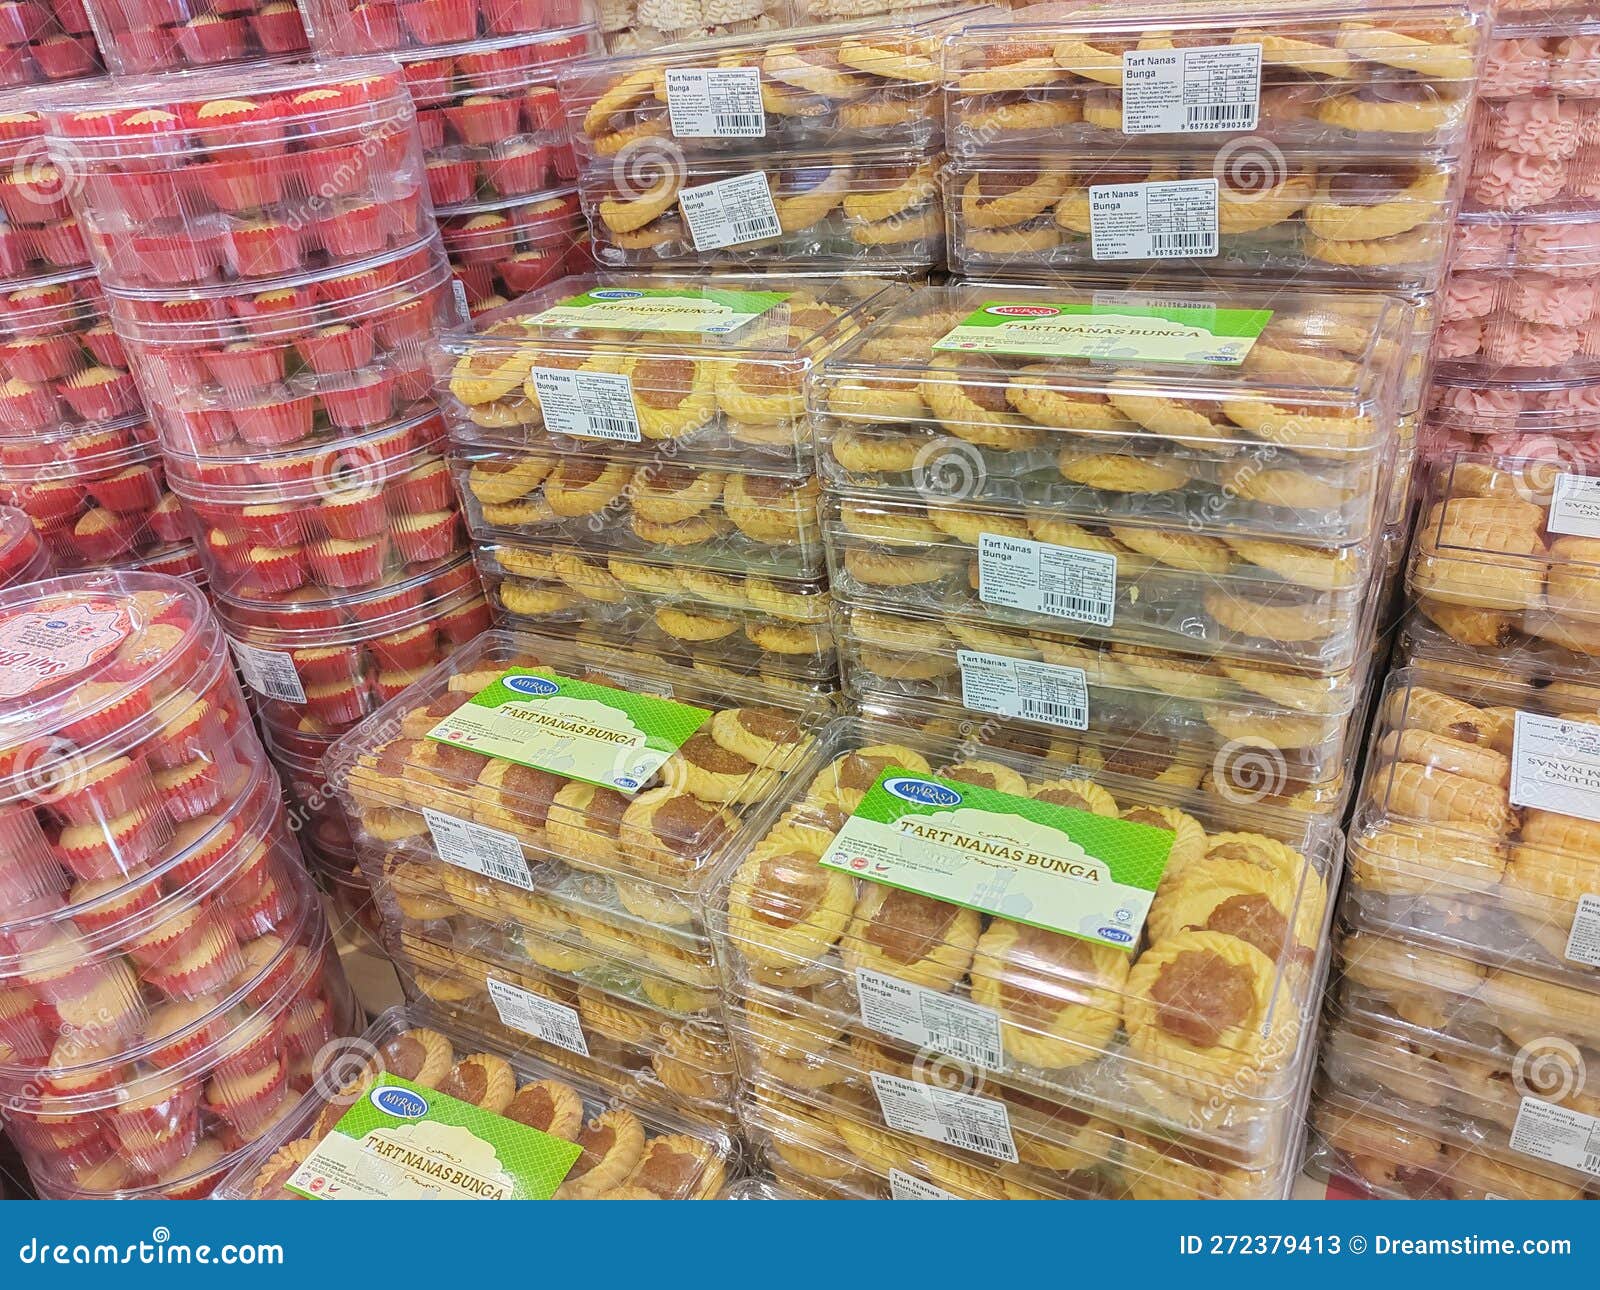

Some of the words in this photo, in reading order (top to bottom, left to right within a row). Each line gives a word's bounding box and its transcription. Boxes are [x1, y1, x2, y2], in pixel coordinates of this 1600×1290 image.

[1127, 58, 1145, 66] Tart
[1147, 56, 1176, 65] Nanas
[669, 74, 682, 82] Tart
[682, 74, 702, 82] Nanas
[1126, 70, 1156, 79] Bunga
[670, 85, 690, 93] Bunga
[682, 193, 695, 201] Tart
[695, 190, 714, 199] Nanas
[1093, 191, 1110, 199] Tart
[685, 202, 705, 211] Bunga
[1093, 202, 1121, 211] Bunga
[591, 304, 627, 312] TART
[625, 305, 674, 314] NANAS
[675, 307, 724, 315] BUNGA
[1006, 324, 1056, 333] TART
[1056, 325, 1128, 337] NANAS
[1129, 328, 1203, 339] BUNGA
[550, 374, 571, 382] Nanas
[537, 382, 558, 391] Bunga
[984, 539, 1001, 549] Tart
[1003, 542, 1032, 554] Nanas
[982, 550, 1012, 561] Bunga
[961, 655, 978, 664] Tart
[980, 657, 1007, 667] Nanas
[516, 678, 555, 696] MYRASA
[499, 705, 538, 724] TART
[536, 715, 587, 734] NANAS
[587, 727, 638, 747] BUNGA
[1528, 757, 1582, 775] NANAS
[902, 781, 957, 807] MYRASA
[900, 821, 954, 843] TART
[954, 835, 1025, 862] NANAS
[1028, 854, 1101, 882] BUNGA
[861, 974, 879, 985] Tart
[881, 980, 912, 996] Nanas
[861, 982, 892, 997] Bunga
[875, 1076, 892, 1087] Tart
[894, 1081, 923, 1094] Nanas
[877, 1084, 906, 1097] Bunga
[382, 1092, 424, 1118] MYRASA
[1524, 1102, 1548, 1113] Biskut
[1549, 1109, 1575, 1122] Gulung
[364, 1134, 406, 1160] TART
[396, 1147, 453, 1184] NANAS
[450, 1171, 504, 1200] BUNGA
[893, 1180, 922, 1196] Bunga
[894, 1173, 911, 1184] Tart
[912, 1180, 940, 1198] Nanas
